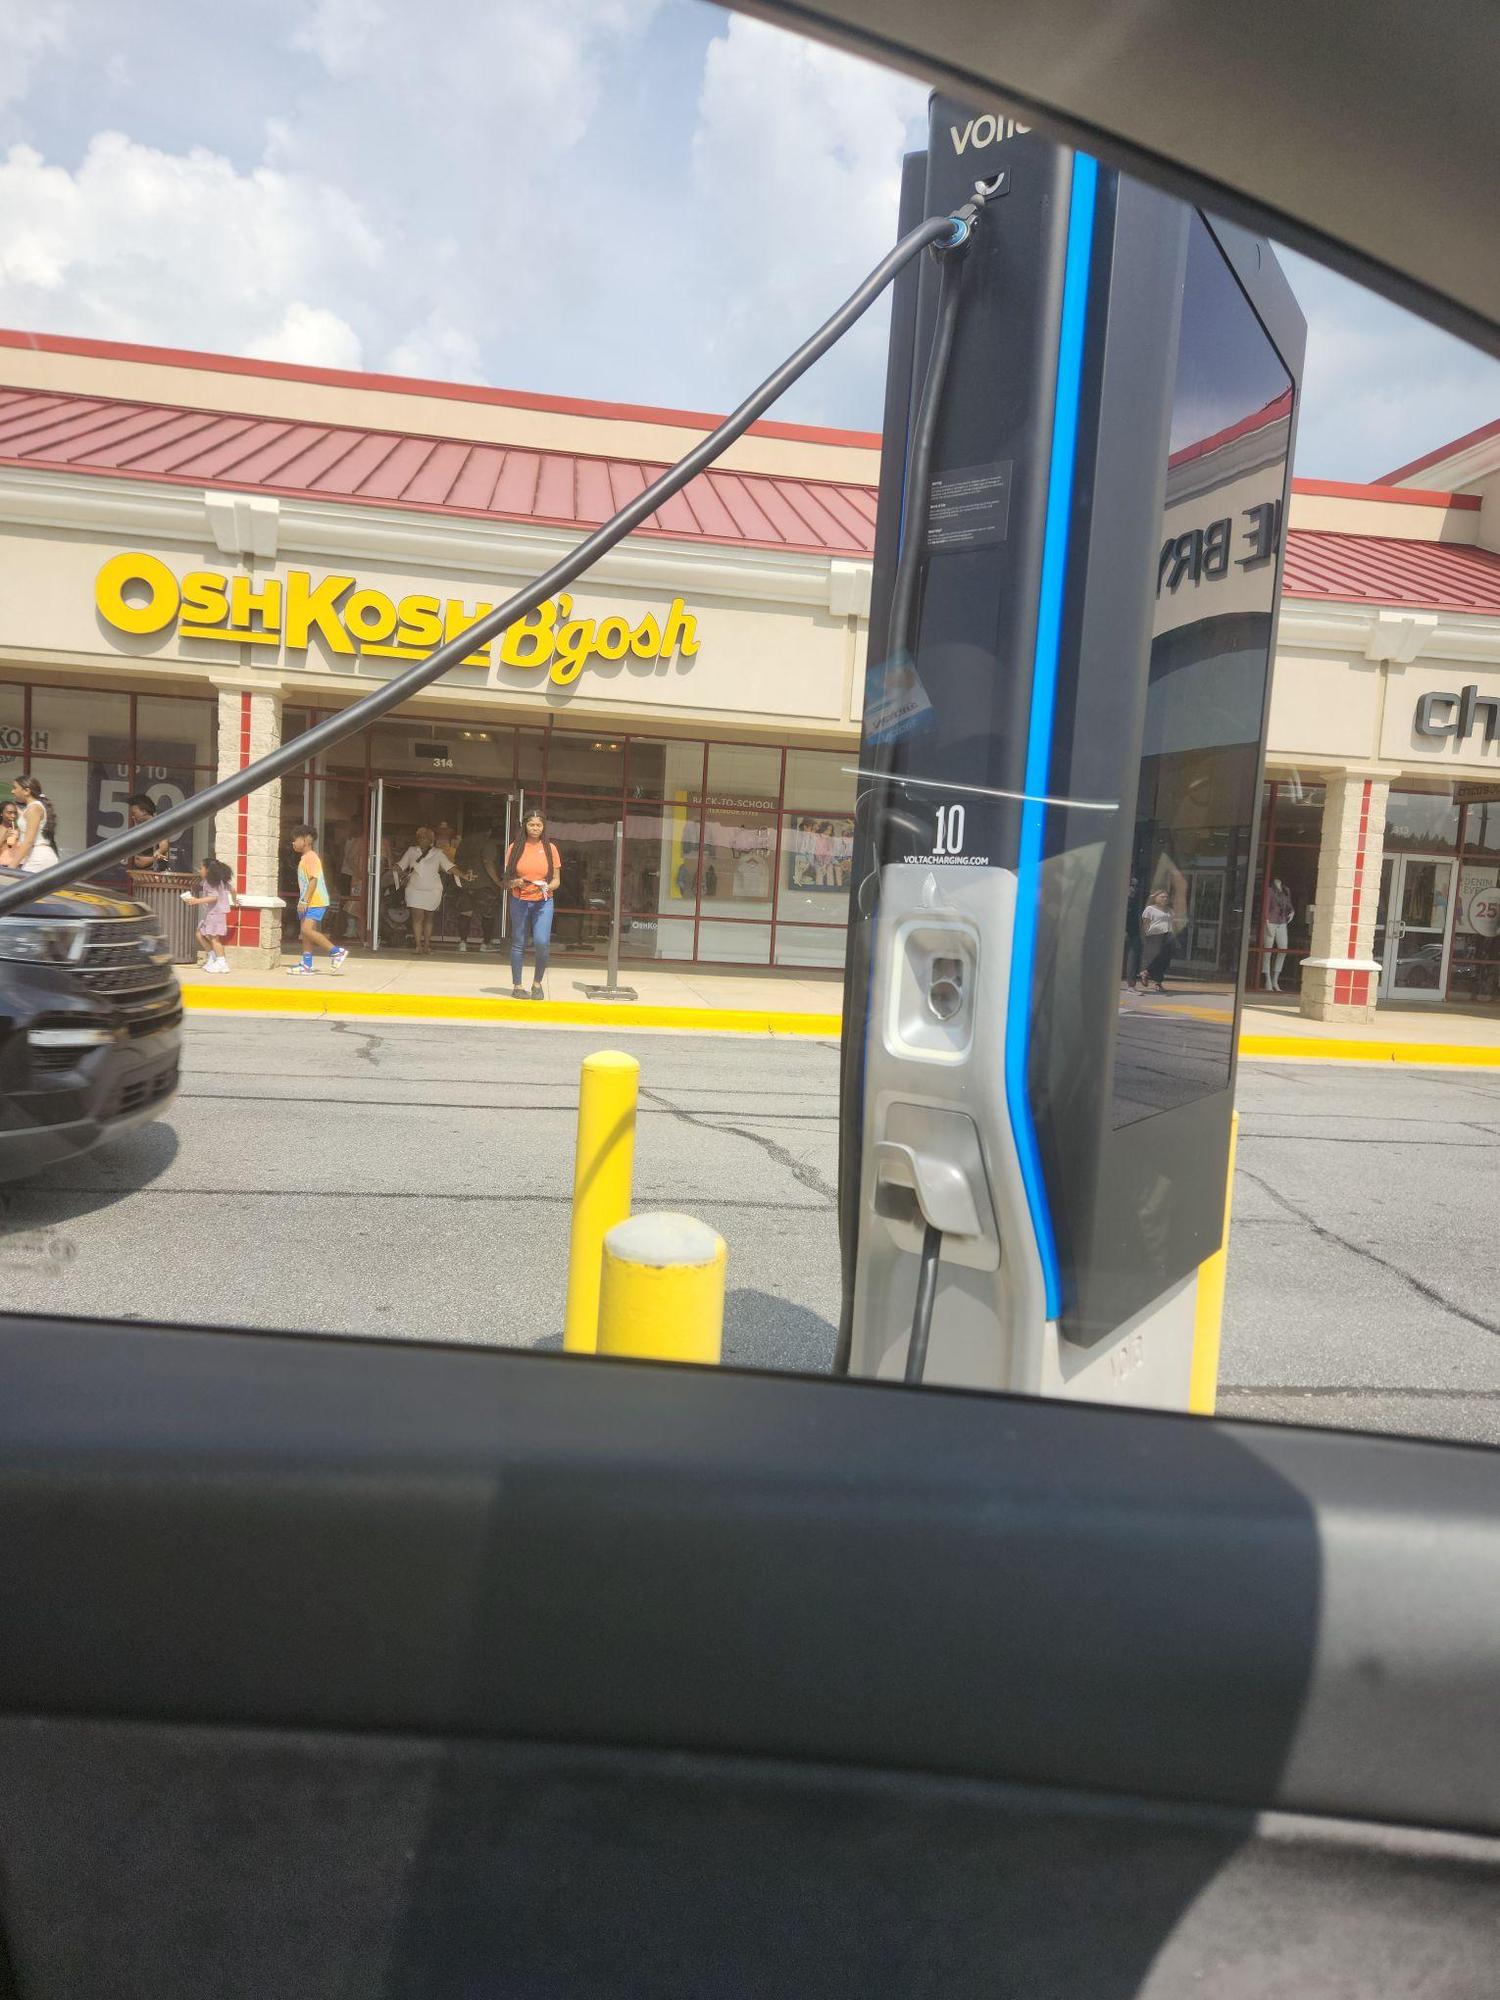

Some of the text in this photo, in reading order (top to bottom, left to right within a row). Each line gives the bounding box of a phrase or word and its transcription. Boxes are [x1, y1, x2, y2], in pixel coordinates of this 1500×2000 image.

[432, 758, 453, 768] 314
[932, 805, 965, 854] 10
[903, 855, 989, 866] VOLTACHARGING.COM
